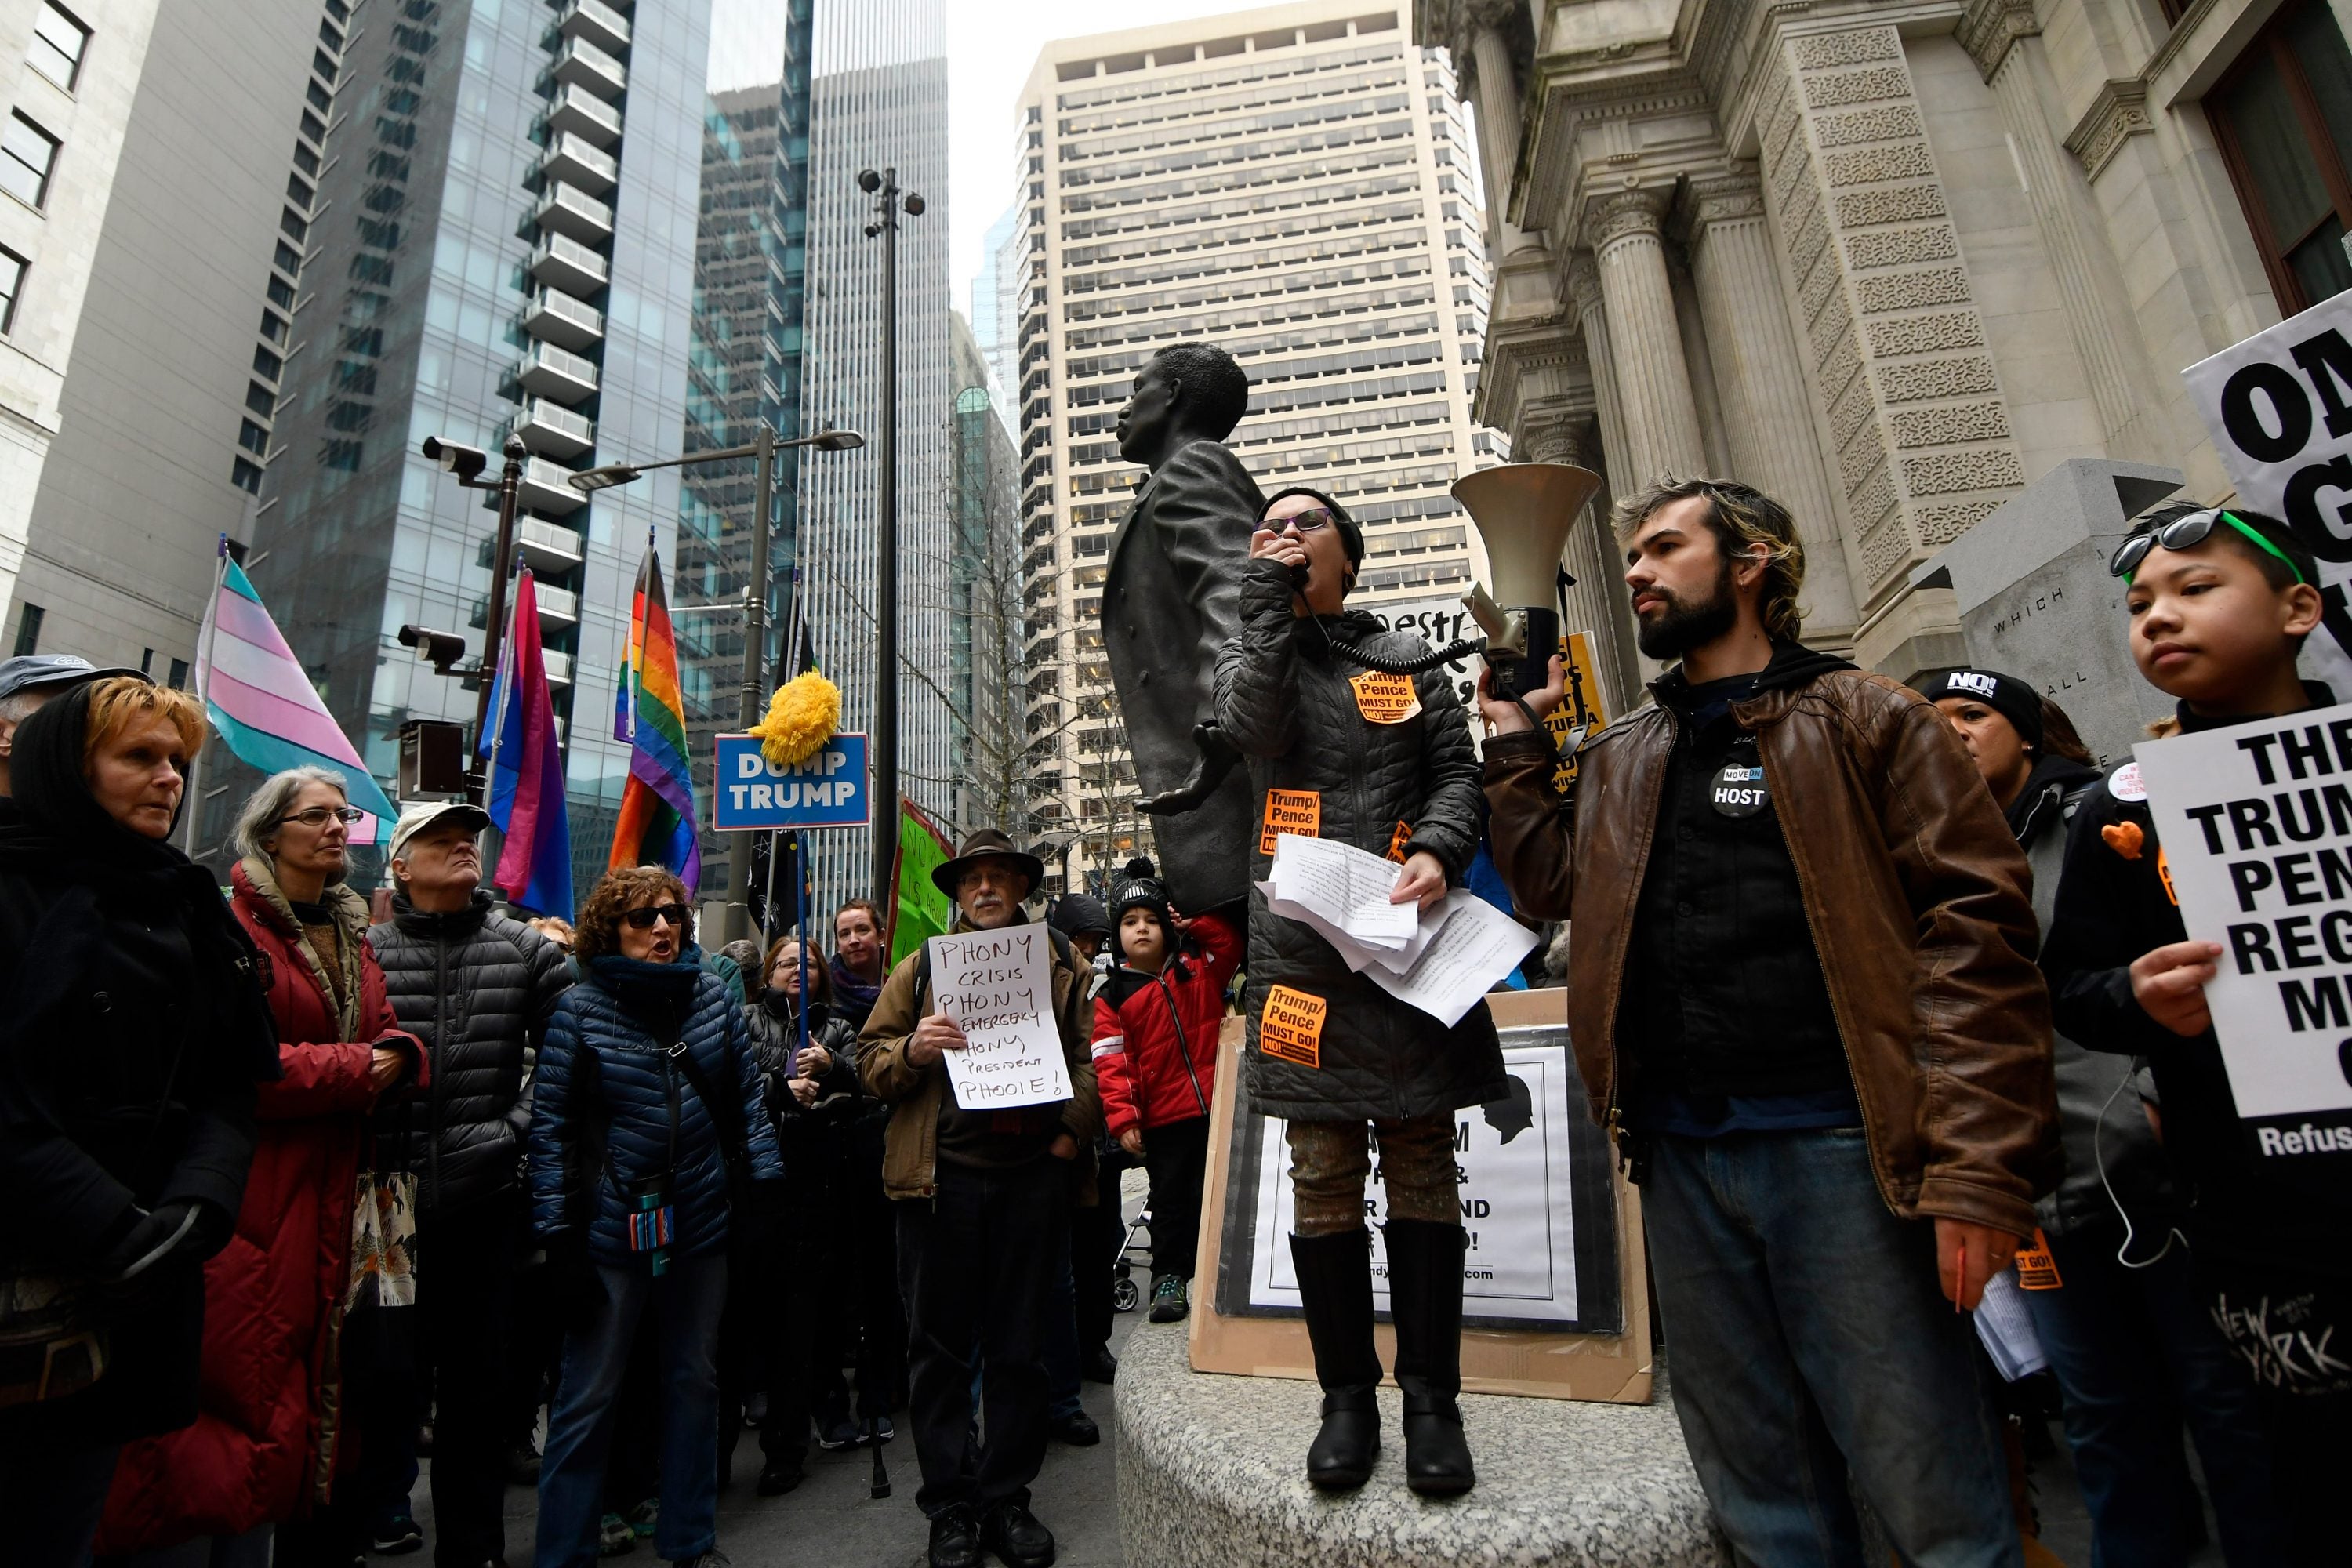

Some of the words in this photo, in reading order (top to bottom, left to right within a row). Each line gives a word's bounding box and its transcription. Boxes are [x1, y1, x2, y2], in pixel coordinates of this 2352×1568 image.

[1994, 588, 2063, 633] WHICH
[1359, 684, 1409, 696] Pence
[1947, 672, 1997, 695] NO!
[1359, 698, 1392, 707] MUST
[1364, 710, 1384, 720] NO!
[729, 782, 856, 810] TRUMP
[1271, 792, 1319, 811] Trump/
[1715, 787, 1765, 805] HOST
[1272, 807, 1314, 824] Pence
[1298, 827, 1316, 838] GO!
[908, 874, 921, 908] IS
[926, 892, 948, 931] ABOVE
[938, 935, 1032, 969] PHONY
[957, 968, 1023, 986] CRISIS
[938, 987, 1033, 1015] PHONY
[1272, 988, 1325, 1015] Trump/
[1269, 1005, 1316, 1031] Pence
[1263, 1022, 1294, 1041] MUST
[1297, 1033, 1316, 1049] GO!
[1264, 1037, 1282, 1054] NO!
[961, 1058, 1042, 1075] PRESIDENT
[2028, 1254, 2052, 1268] GO!
[2238, 1323, 2352, 1388] YORK
